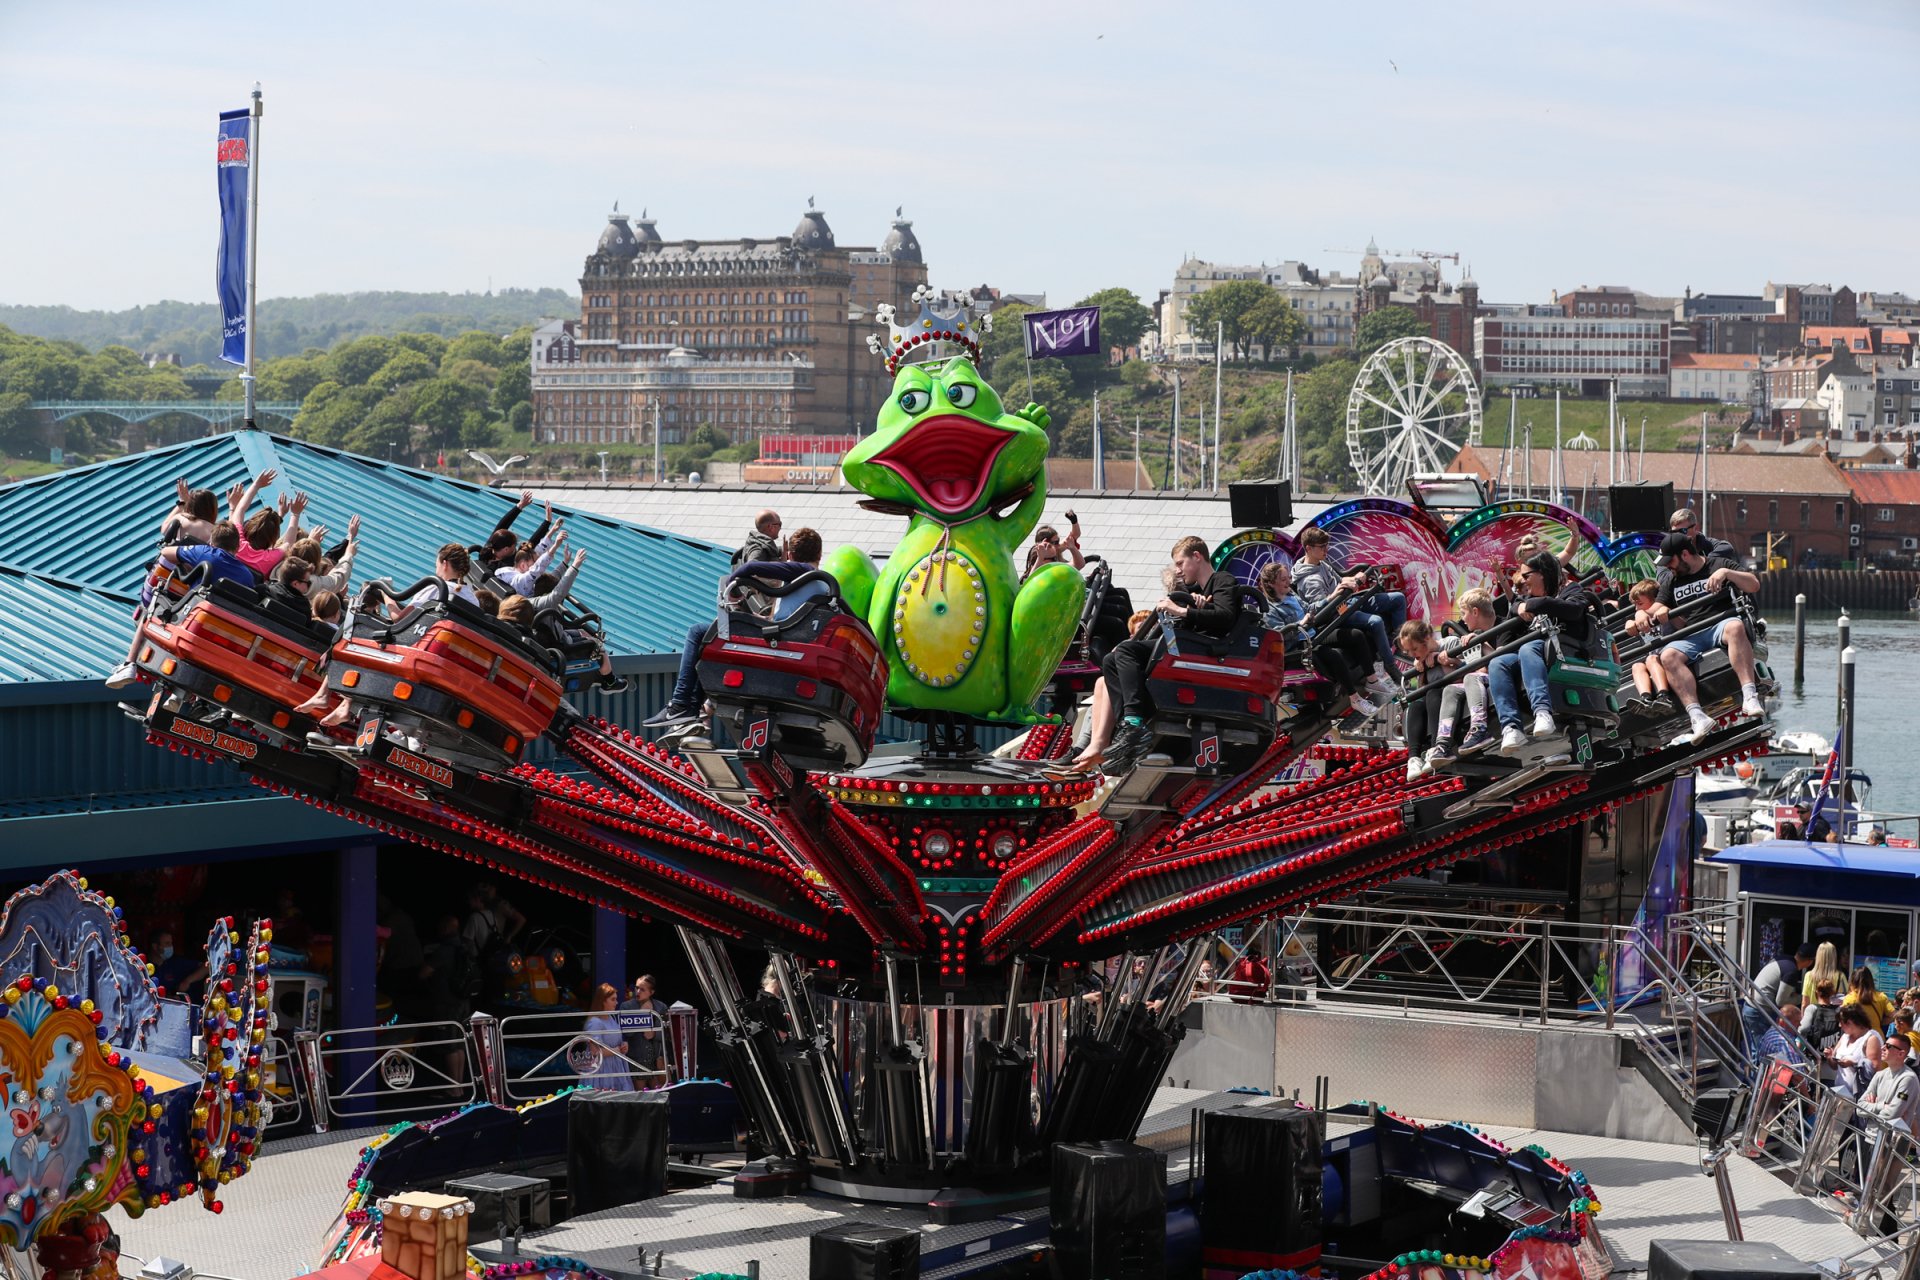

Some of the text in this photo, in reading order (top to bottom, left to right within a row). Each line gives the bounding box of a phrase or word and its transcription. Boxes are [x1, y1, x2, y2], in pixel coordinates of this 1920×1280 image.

[413, 623, 428, 637] 14
[1249, 636, 1259, 648] 2
[1599, 638, 1608, 649] 3
[170, 717, 257, 759] HONG KONG
[386, 747, 454, 789] AUSTRALIA
[620, 1016, 651, 1025] NO EXIT
